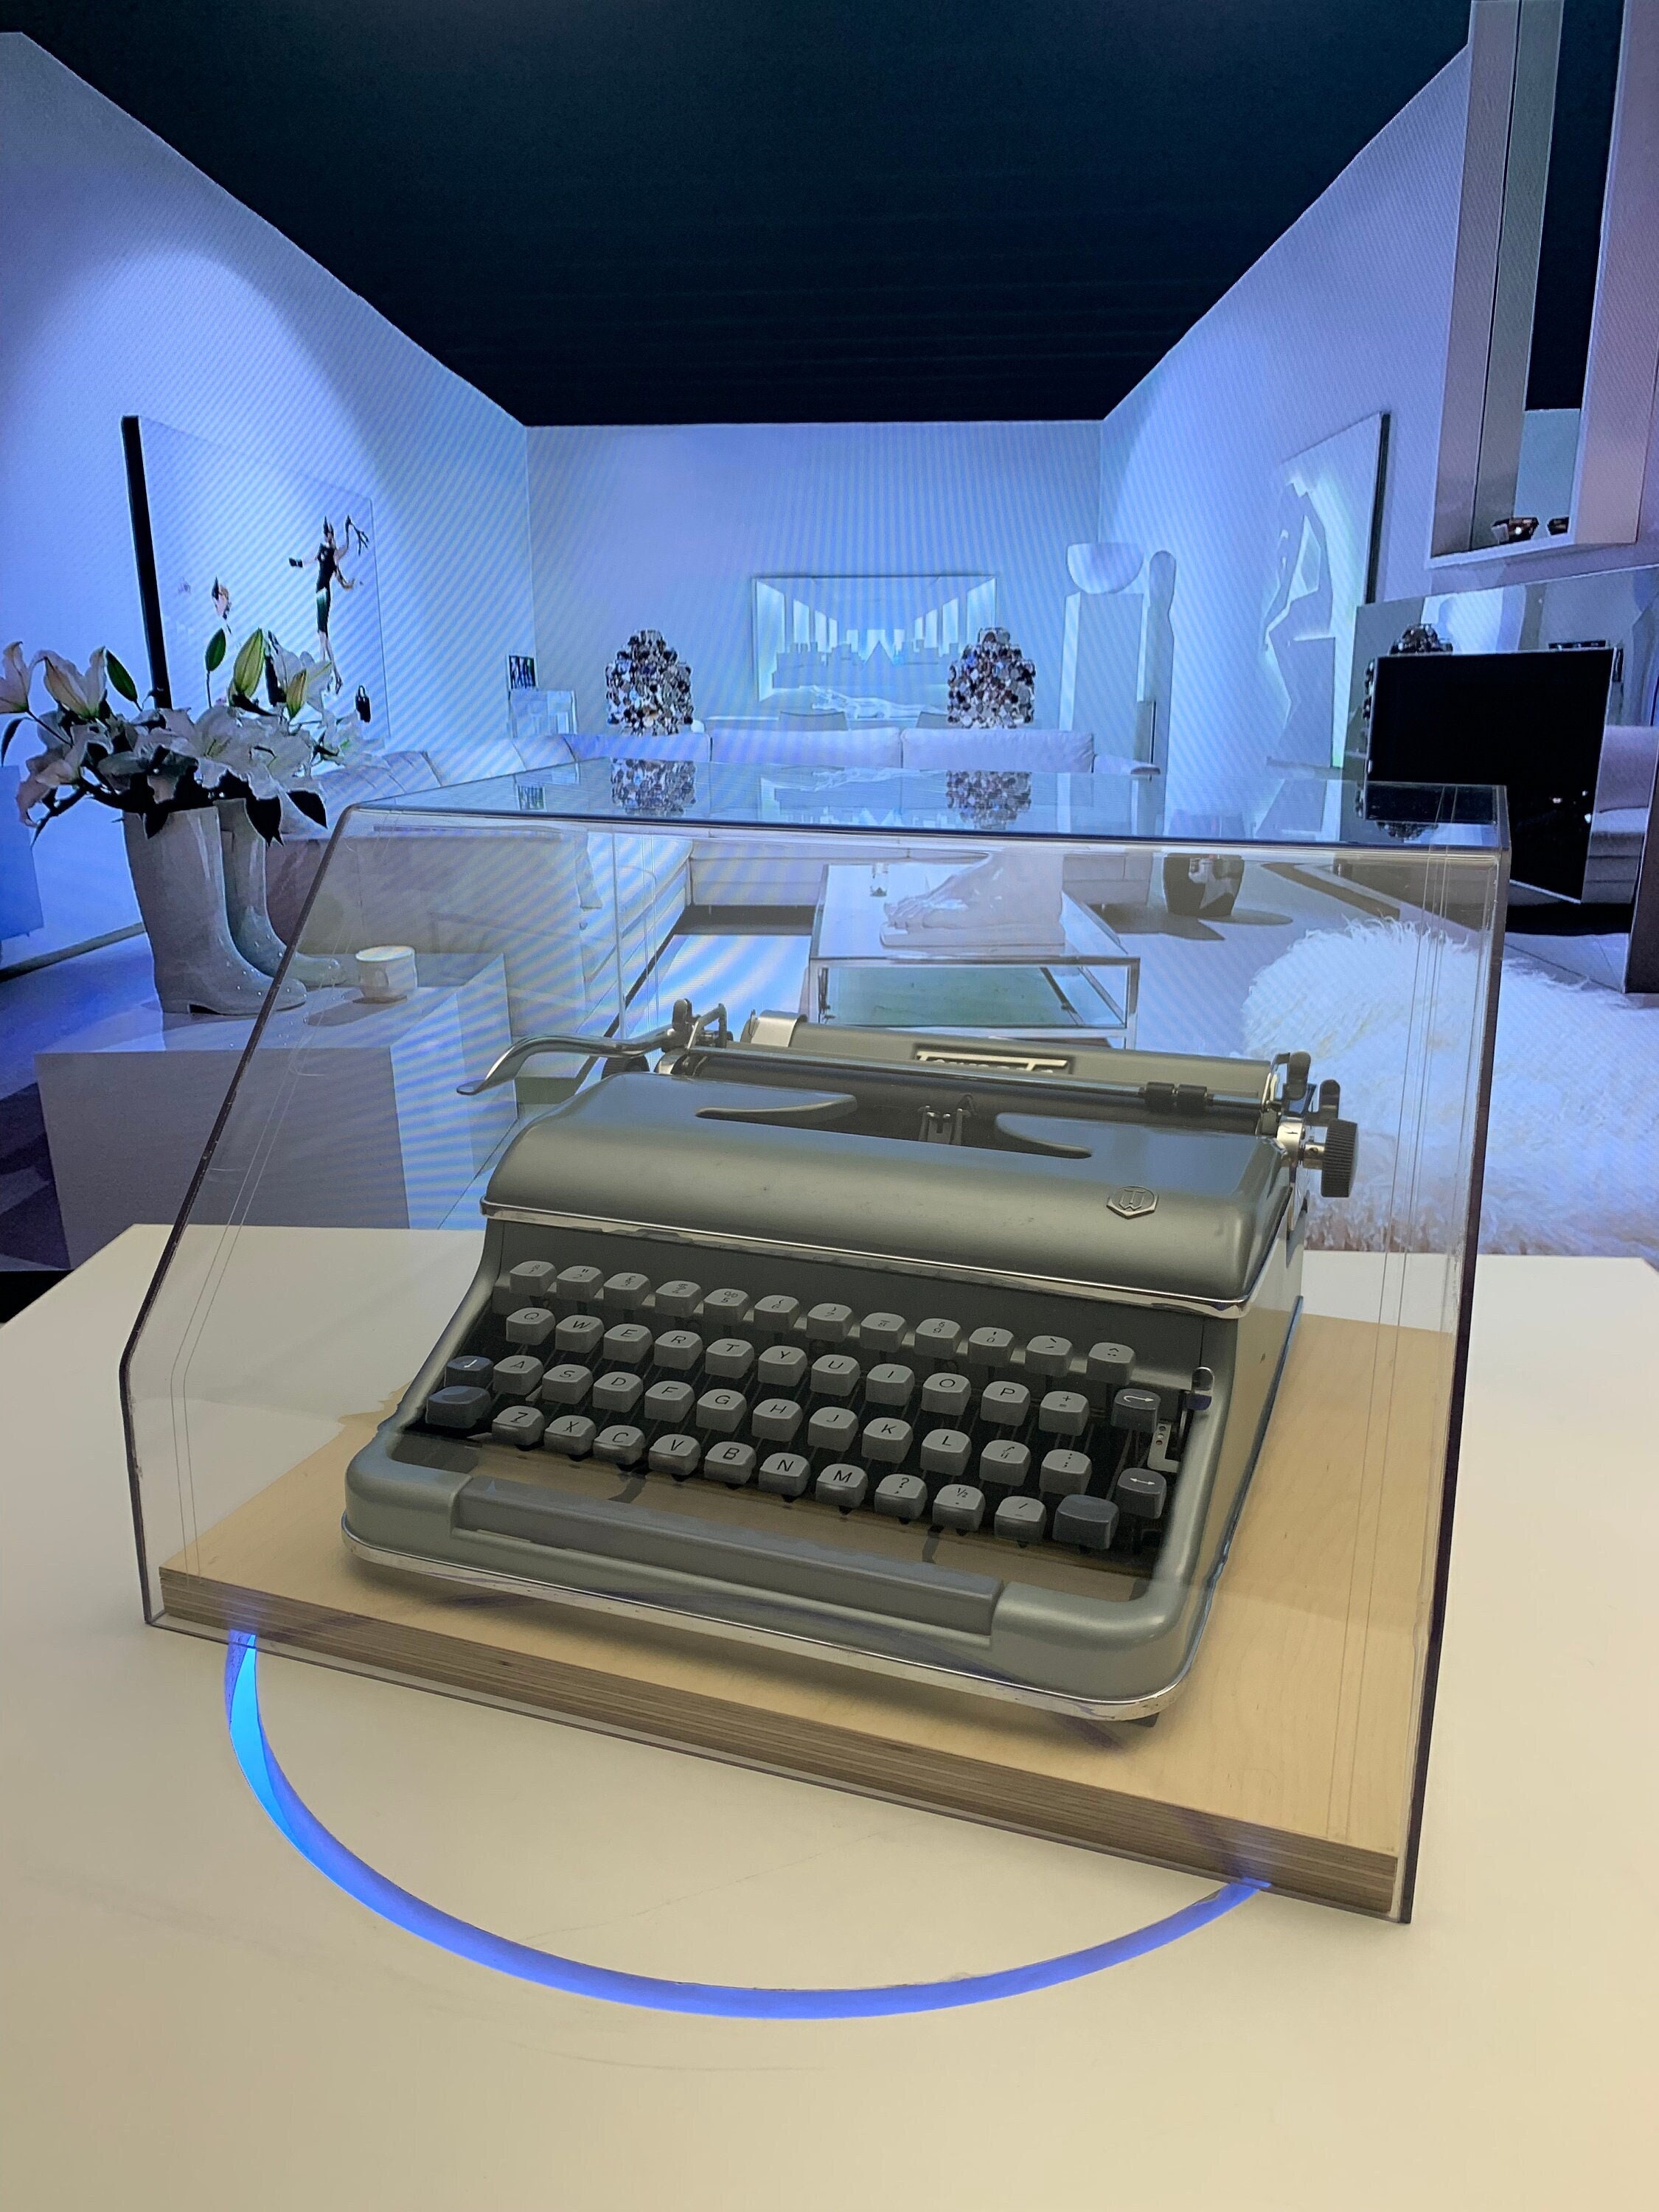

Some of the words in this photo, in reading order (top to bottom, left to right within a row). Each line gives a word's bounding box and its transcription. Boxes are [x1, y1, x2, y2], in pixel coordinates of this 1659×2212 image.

[524, 1312, 539, 1321] Q
[572, 1320, 591, 1329] W
[620, 1329, 638, 1338] E
[670, 1335, 686, 1344] R
[726, 1343, 740, 1352] T
[779, 1350, 791, 1360] Y
[827, 1360, 844, 1370] U
[939, 1378, 956, 1388] O
[1000, 1387, 1015, 1396] P
[509, 1360, 525, 1369] A
[559, 1370, 575, 1379] S
[611, 1377, 627, 1386] D
[661, 1386, 679, 1394] F
[714, 1394, 731, 1405] G
[769, 1404, 787, 1414] H
[826, 1413, 840, 1423] J
[880, 1423, 897, 1435] K
[941, 1435, 952, 1447] L
[509, 1411, 529, 1424] Z
[562, 1420, 580, 1433] X
[612, 1431, 629, 1444] C
[670, 1439, 684, 1451] V
[722, 1447, 740, 1460] B
[776, 1458, 795, 1472] N
[832, 1470, 853, 1484] M
